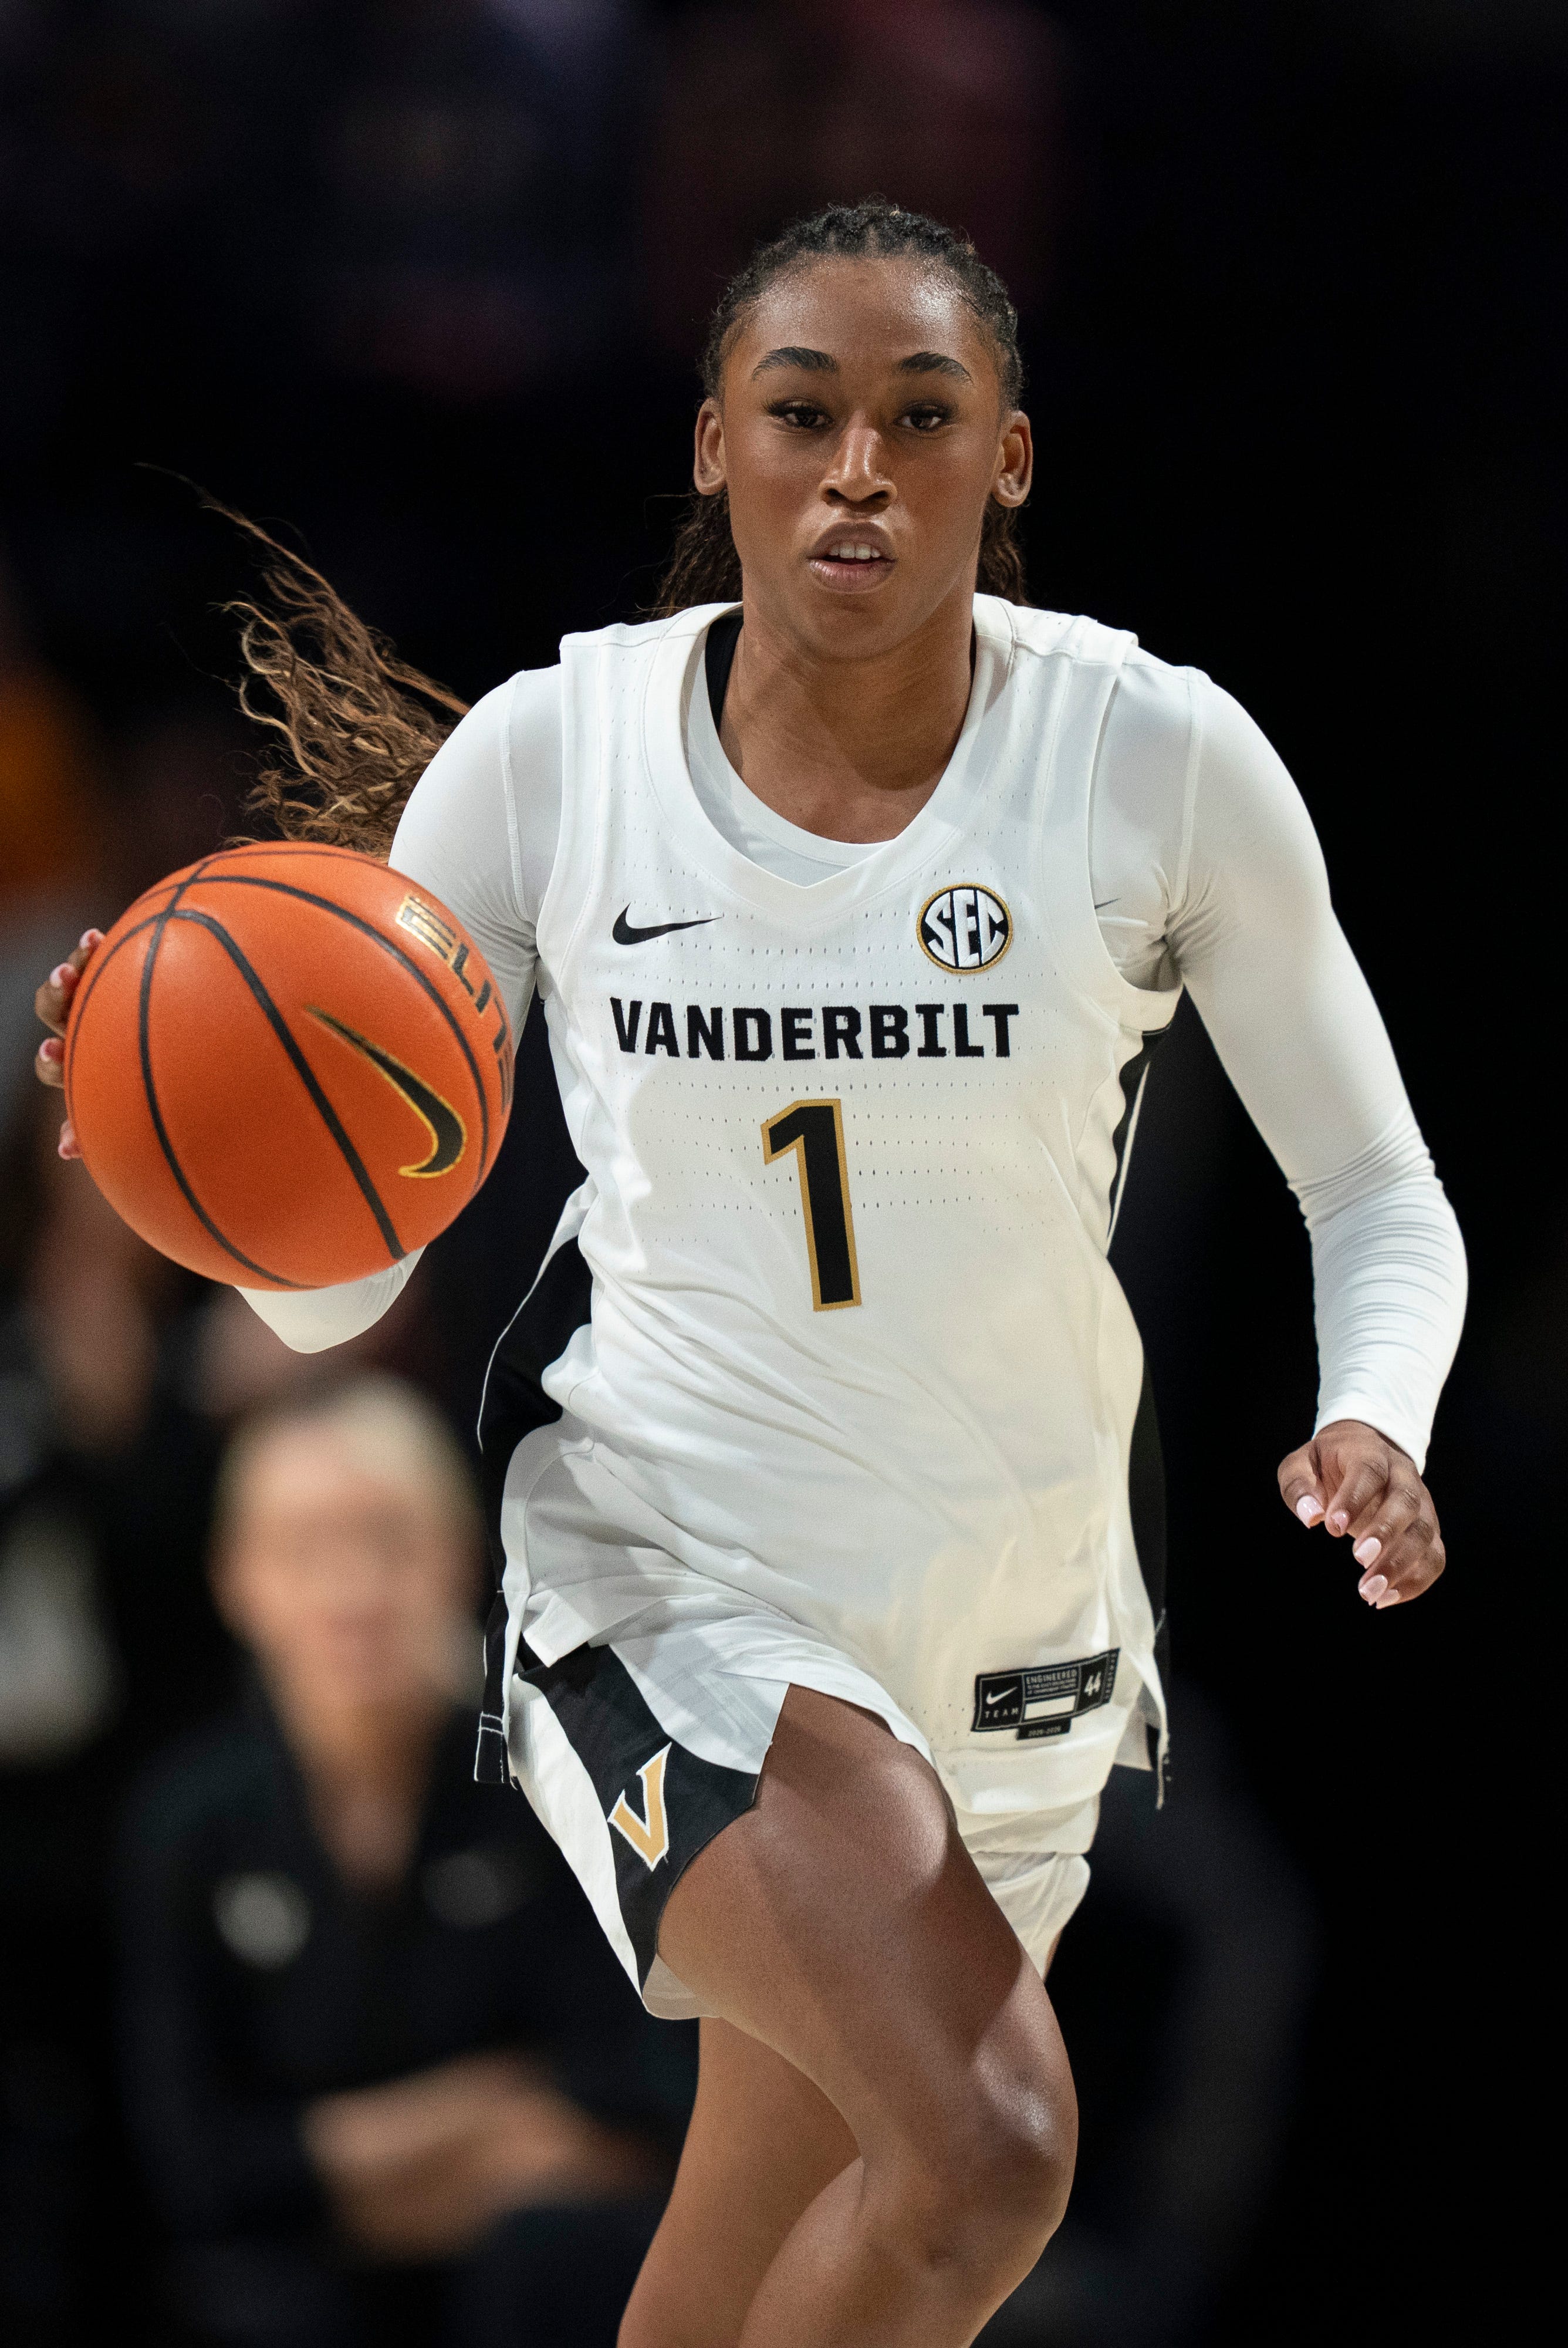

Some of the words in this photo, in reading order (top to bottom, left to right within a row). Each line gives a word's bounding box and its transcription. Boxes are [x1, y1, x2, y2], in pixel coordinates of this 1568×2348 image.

[925, 889, 1005, 967] SEC
[610, 997, 1019, 1061] VANDERBILT
[761, 1099, 861, 1312] 1
[984, 1707, 1019, 1719] TEAM
[1084, 1671, 1101, 1696] 44
[607, 1742, 672, 1871] V
